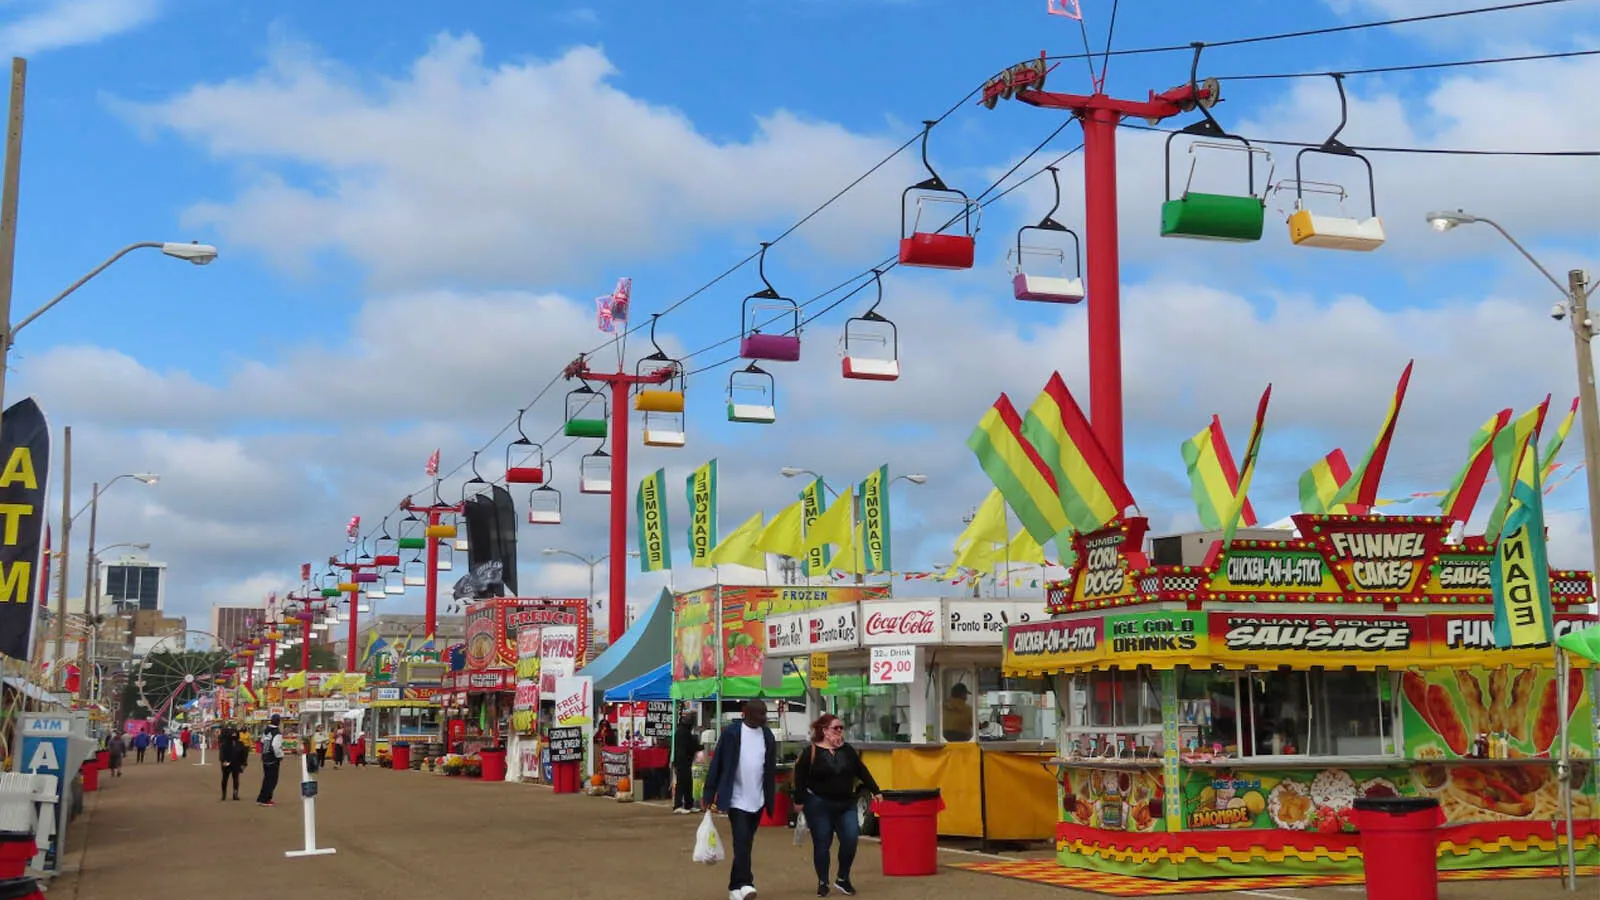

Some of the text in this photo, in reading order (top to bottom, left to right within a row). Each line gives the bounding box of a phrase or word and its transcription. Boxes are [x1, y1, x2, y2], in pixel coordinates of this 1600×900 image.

[0, 447, 38, 603] ATM
[1330, 532, 1425, 559] FUNNEL
[1088, 546, 1118, 570] CORN
[1084, 568, 1124, 597] DOGS
[1227, 557, 1323, 587] CHICKEN-ON-A-STICK
[1352, 561, 1412, 589] CAKES
[1440, 567, 1492, 588] SAUS
[782, 590, 828, 600] FROZEN
[508, 609, 576, 625] FRENCH
[951, 612, 981, 632] Pronto
[1113, 618, 1194, 634] ICE COLD
[1227, 617, 1310, 626] ITALIAN
[1335, 619, 1408, 627] POLISH
[1013, 626, 1097, 653] CHICKEN-ON-A-STICK
[1113, 634, 1197, 653] DRINKS
[1225, 625, 1411, 650] SAUSAGE
[1447, 619, 1496, 650] FUN
[890, 649, 912, 657] Drink
[873, 660, 912, 681] $2.00
[556, 693, 581, 711] FREE
[32, 719, 62, 730] ATM
[1187, 806, 1249, 829] LEMONADE
